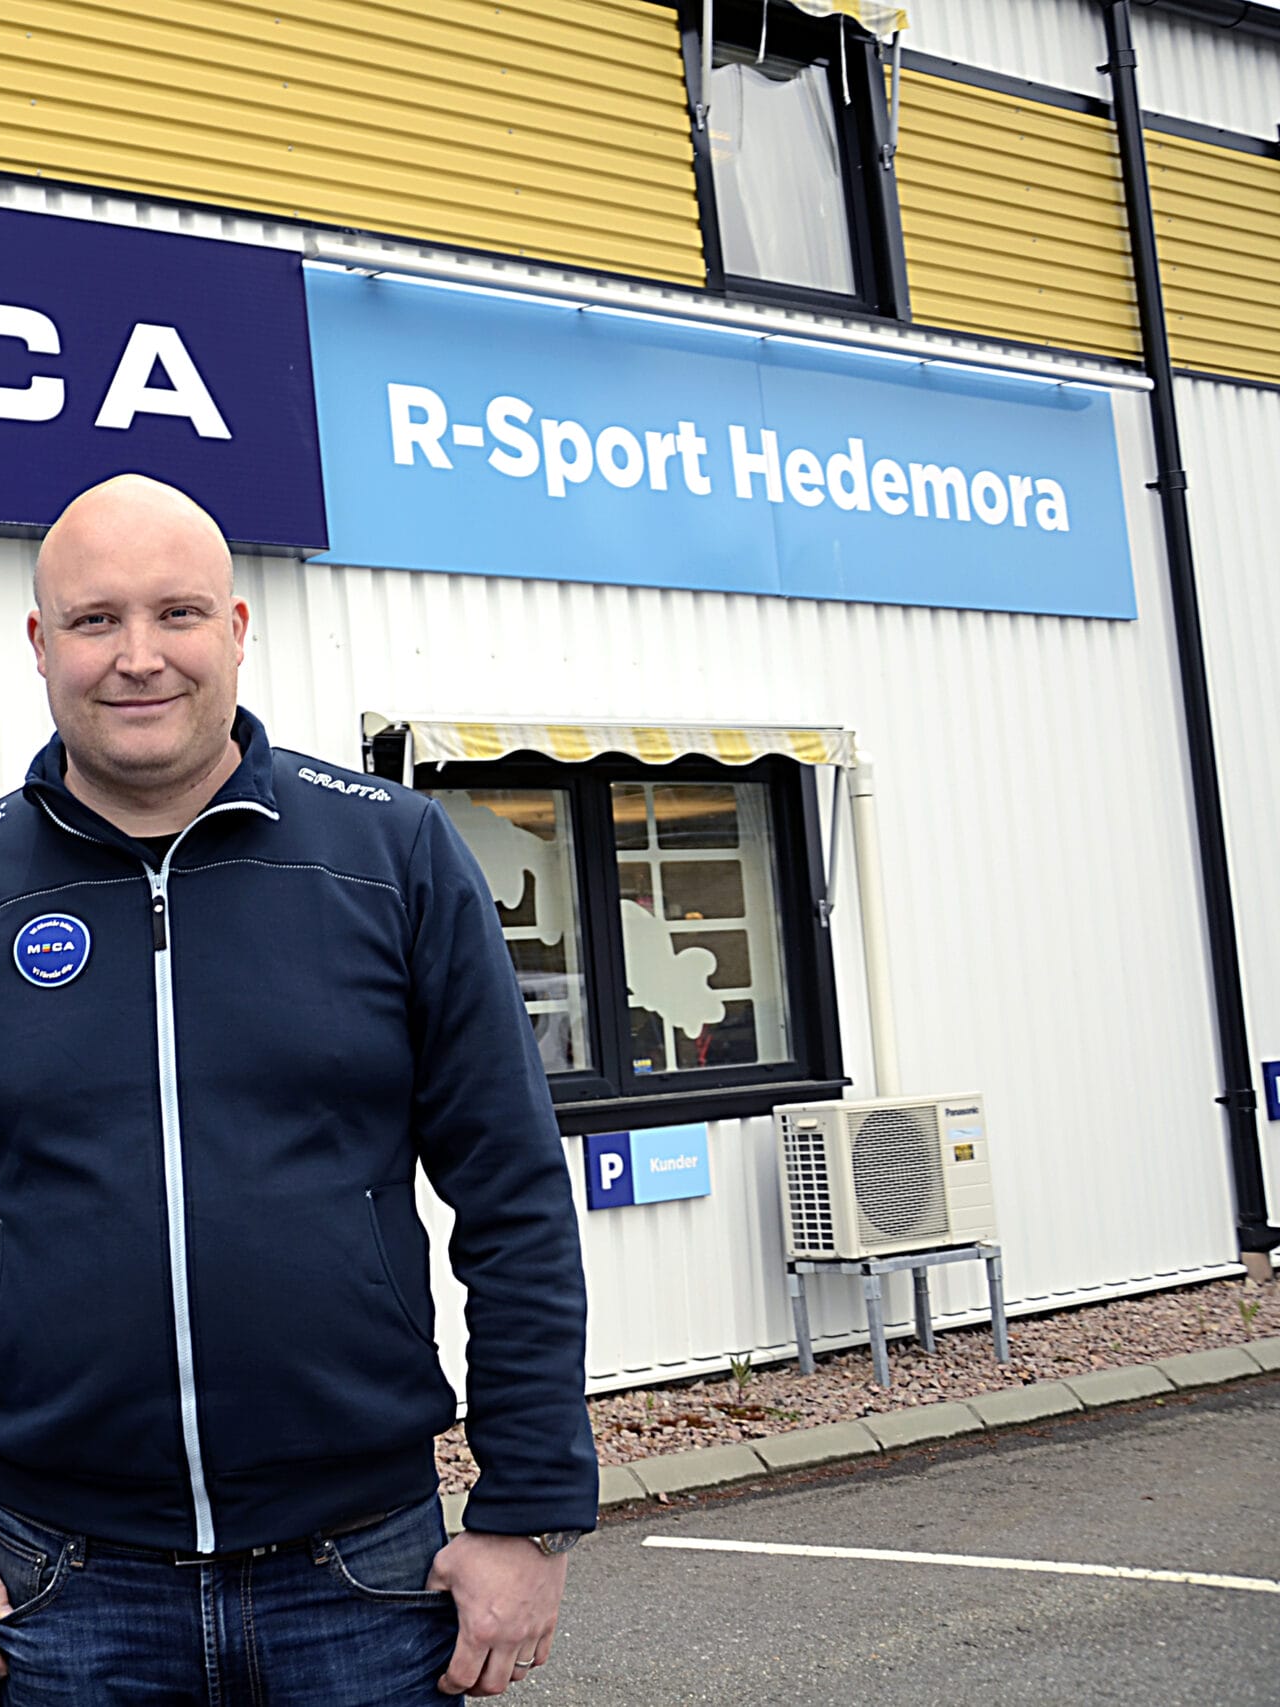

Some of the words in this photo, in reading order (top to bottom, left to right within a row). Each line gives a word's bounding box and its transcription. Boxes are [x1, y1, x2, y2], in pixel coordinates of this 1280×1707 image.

[386, 382, 712, 499] R-Sport
[728, 423, 1071, 533] Hedemora
[27, 941, 75, 954] MECA
[599, 1153, 624, 1190] P
[650, 1155, 698, 1173] Kunder
